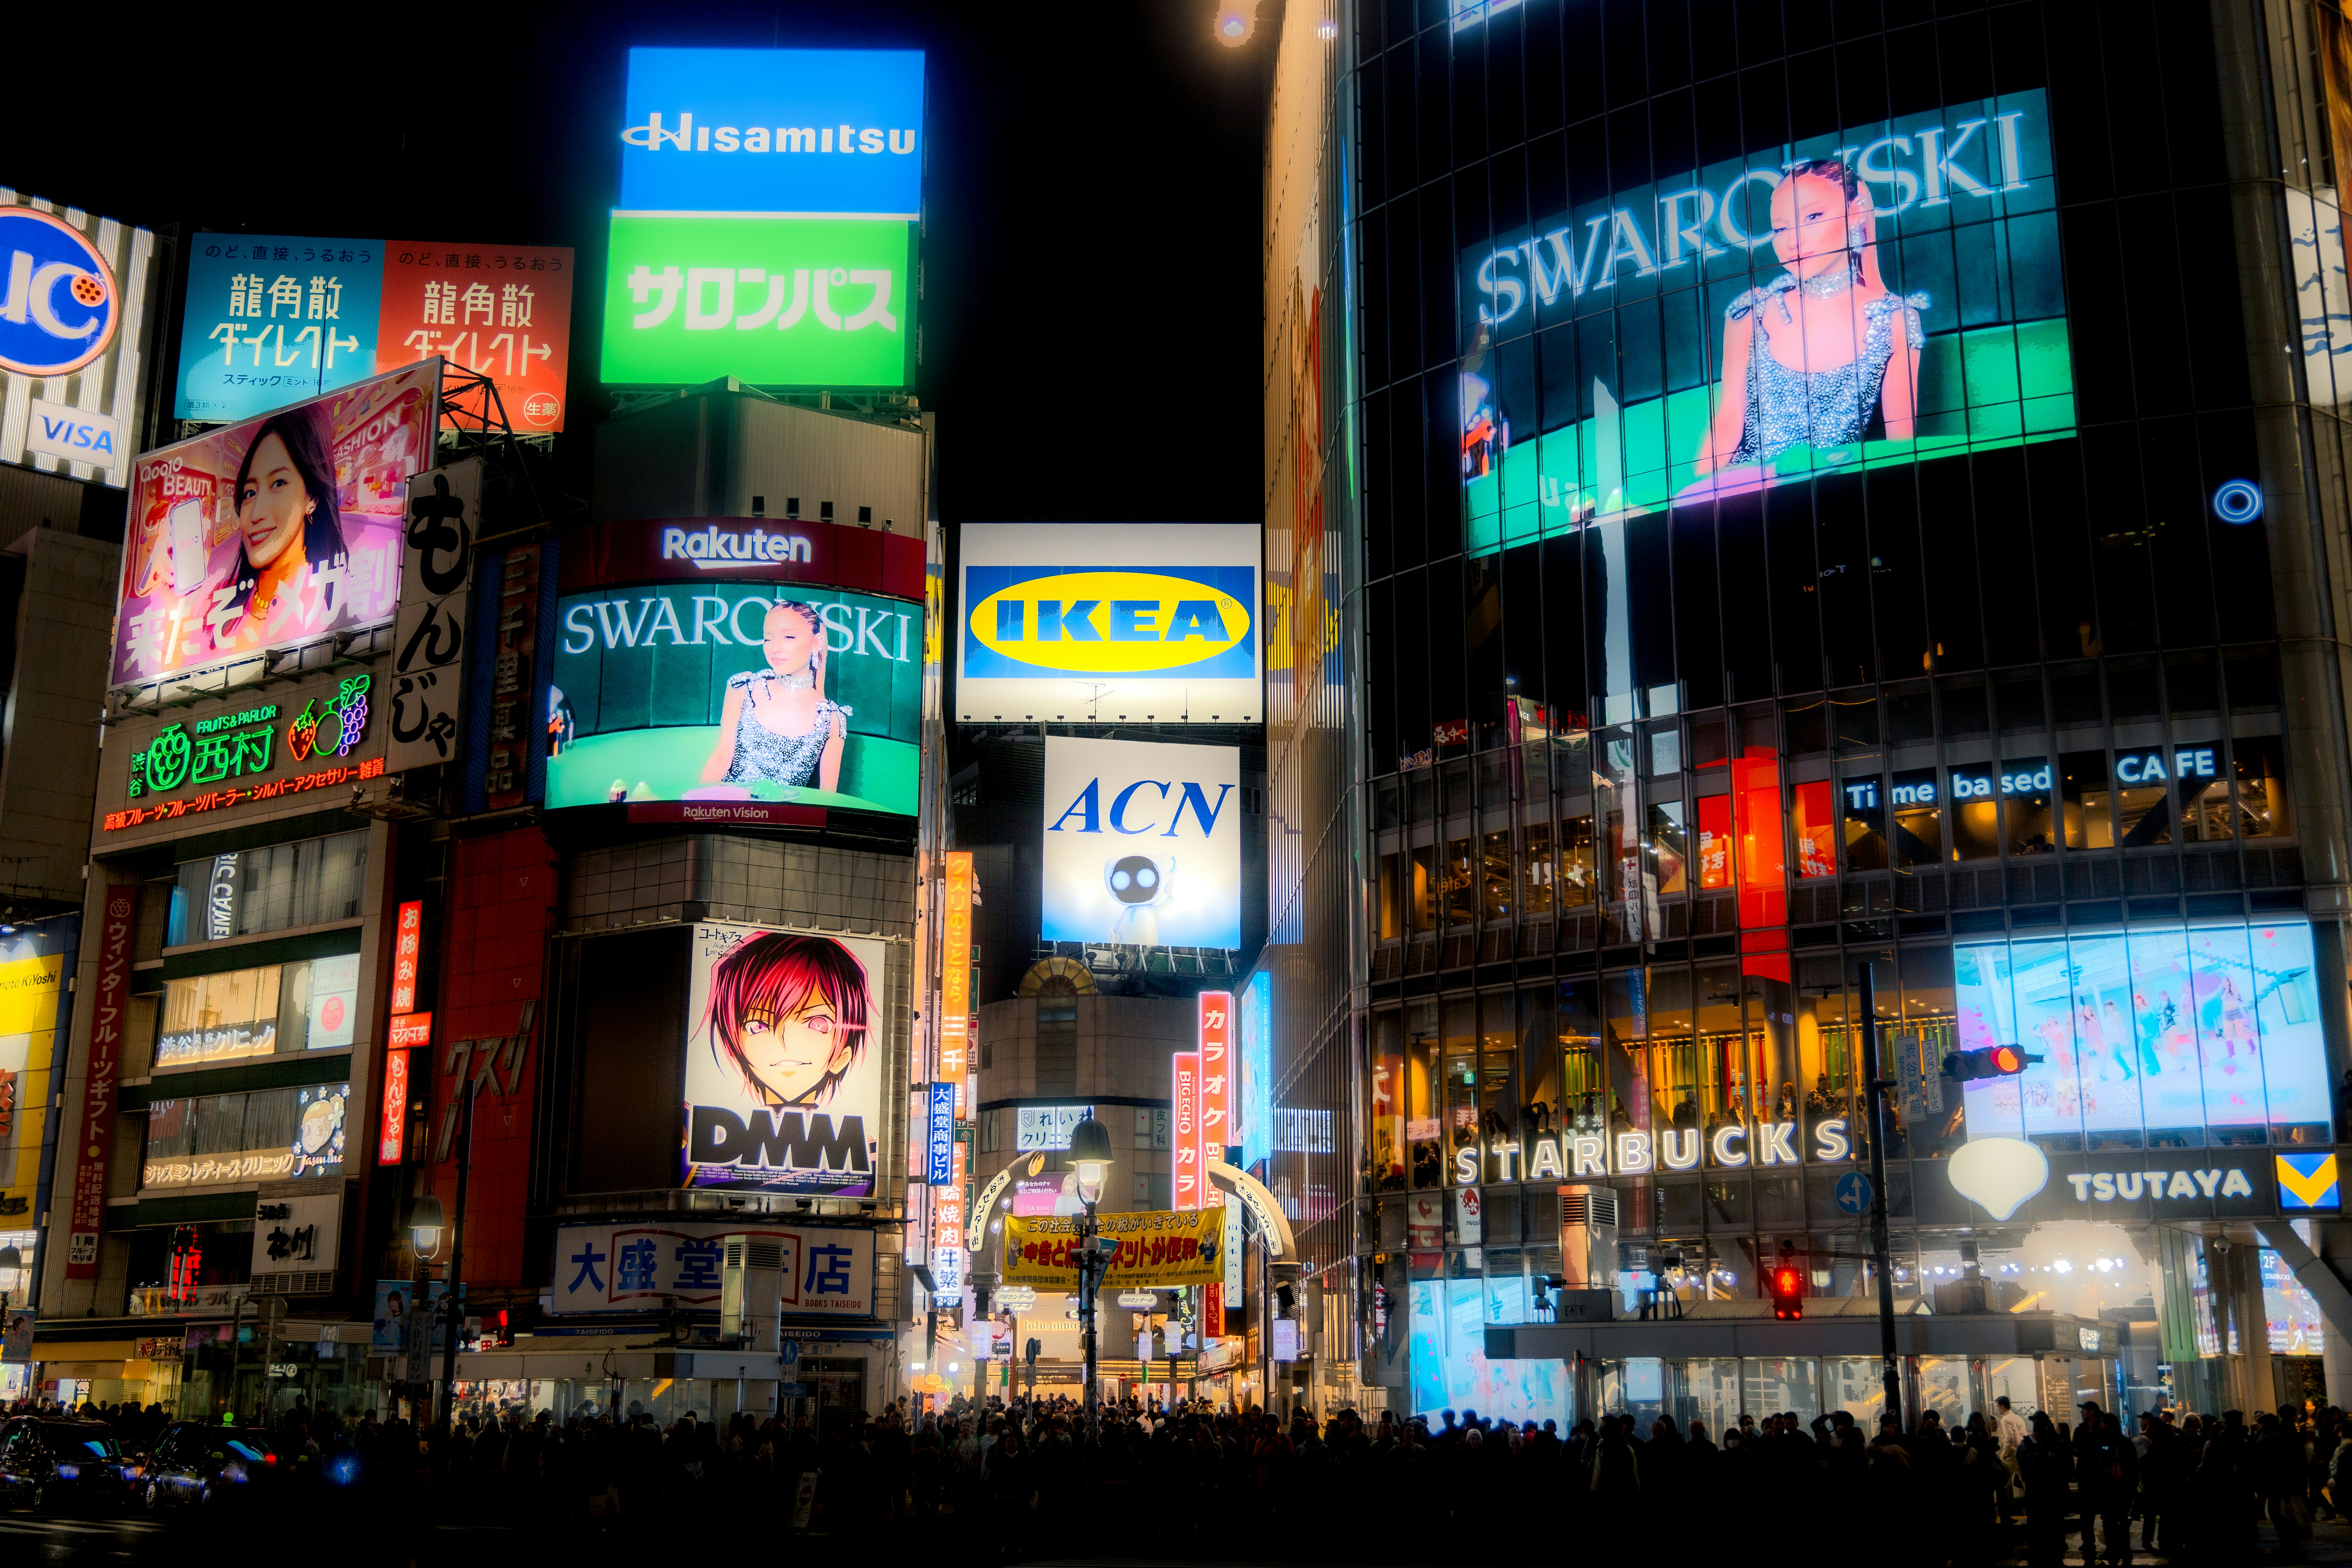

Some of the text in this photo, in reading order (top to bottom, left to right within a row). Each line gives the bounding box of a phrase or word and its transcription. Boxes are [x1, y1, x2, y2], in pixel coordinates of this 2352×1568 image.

[622, 113, 915, 155] Hisamitsu
[1478, 113, 2029, 326] SWAROSKI
[229, 273, 342, 320] 龍角散
[423, 281, 534, 328] 龍角散
[628, 266, 896, 332] サロンパス
[208, 323, 359, 369] ダイレクト
[404, 330, 552, 376] ダイレクト
[223, 374, 281, 386] スティック
[285, 378, 308, 387] ミント
[527, 403, 557, 416] 生薬
[37, 414, 113, 455] VISA
[333, 408, 400, 460] FASHION
[141, 457, 182, 483] Qoo10
[164, 474, 212, 497] BEAUTY
[664, 526, 811, 563] Rakuten
[123, 539, 397, 674] 来たぞ、メガ割
[392, 474, 471, 757] もんじゃ
[566, 596, 911, 663] SWAROSKI
[996, 600, 1231, 642] IKEA
[130, 753, 146, 797] 渋谷
[192, 725, 274, 784] 西村
[2117, 750, 2214, 783] CAFE
[1953, 765, 2052, 798] based
[684, 806, 768, 818] Rakuten Vision
[1047, 777, 1235, 838] ACN
[699, 928, 745, 944] コードギアス
[947, 859, 967, 1003] クスリのことなら
[396, 907, 418, 1008] お好み焼
[90, 922, 127, 1140] ウィンターフルーツギフト
[394, 1018, 405, 1027] 渋谷
[445, 1034, 528, 1100] クスリ
[1204, 1010, 1226, 1127] カラオケ
[1905, 1043, 1921, 1114] 渋谷駅前
[1925, 1043, 1940, 1110] スクランブル式
[382, 1054, 405, 1160] もんじゃ焼
[1178, 1071, 1191, 1134] BIG ECHO
[690, 1105, 870, 1172] DMM
[932, 1088, 949, 1180] 大盛堂商事ビル
[1021, 1132, 1072, 1147] クリニッ
[1156, 1109, 1166, 1146] 皮フ科
[294, 1153, 344, 1177] Jasmine
[1457, 1119, 1849, 1184] STARBUCKS
[88, 1162, 104, 1227] 無料配送地域
[1177, 1147, 1196, 1210] カラ
[2067, 1169, 2253, 1201] TSUTAYA
[971, 1175, 1005, 1248] 渋谷センター街
[1238, 1184, 1278, 1252] 渋谷センター街
[75, 1236, 94, 1246] 1階
[1228, 1223, 1238, 1303] 山下本気うどん
[2263, 1256, 2274, 1268] 2F
[568, 1238, 852, 1295] 大盛堂店
[939, 1248, 959, 1289] 牛繁
[805, 1299, 862, 1309] BOOKS TAISEIDO
[799, 1345, 833, 1354] 堂書店
